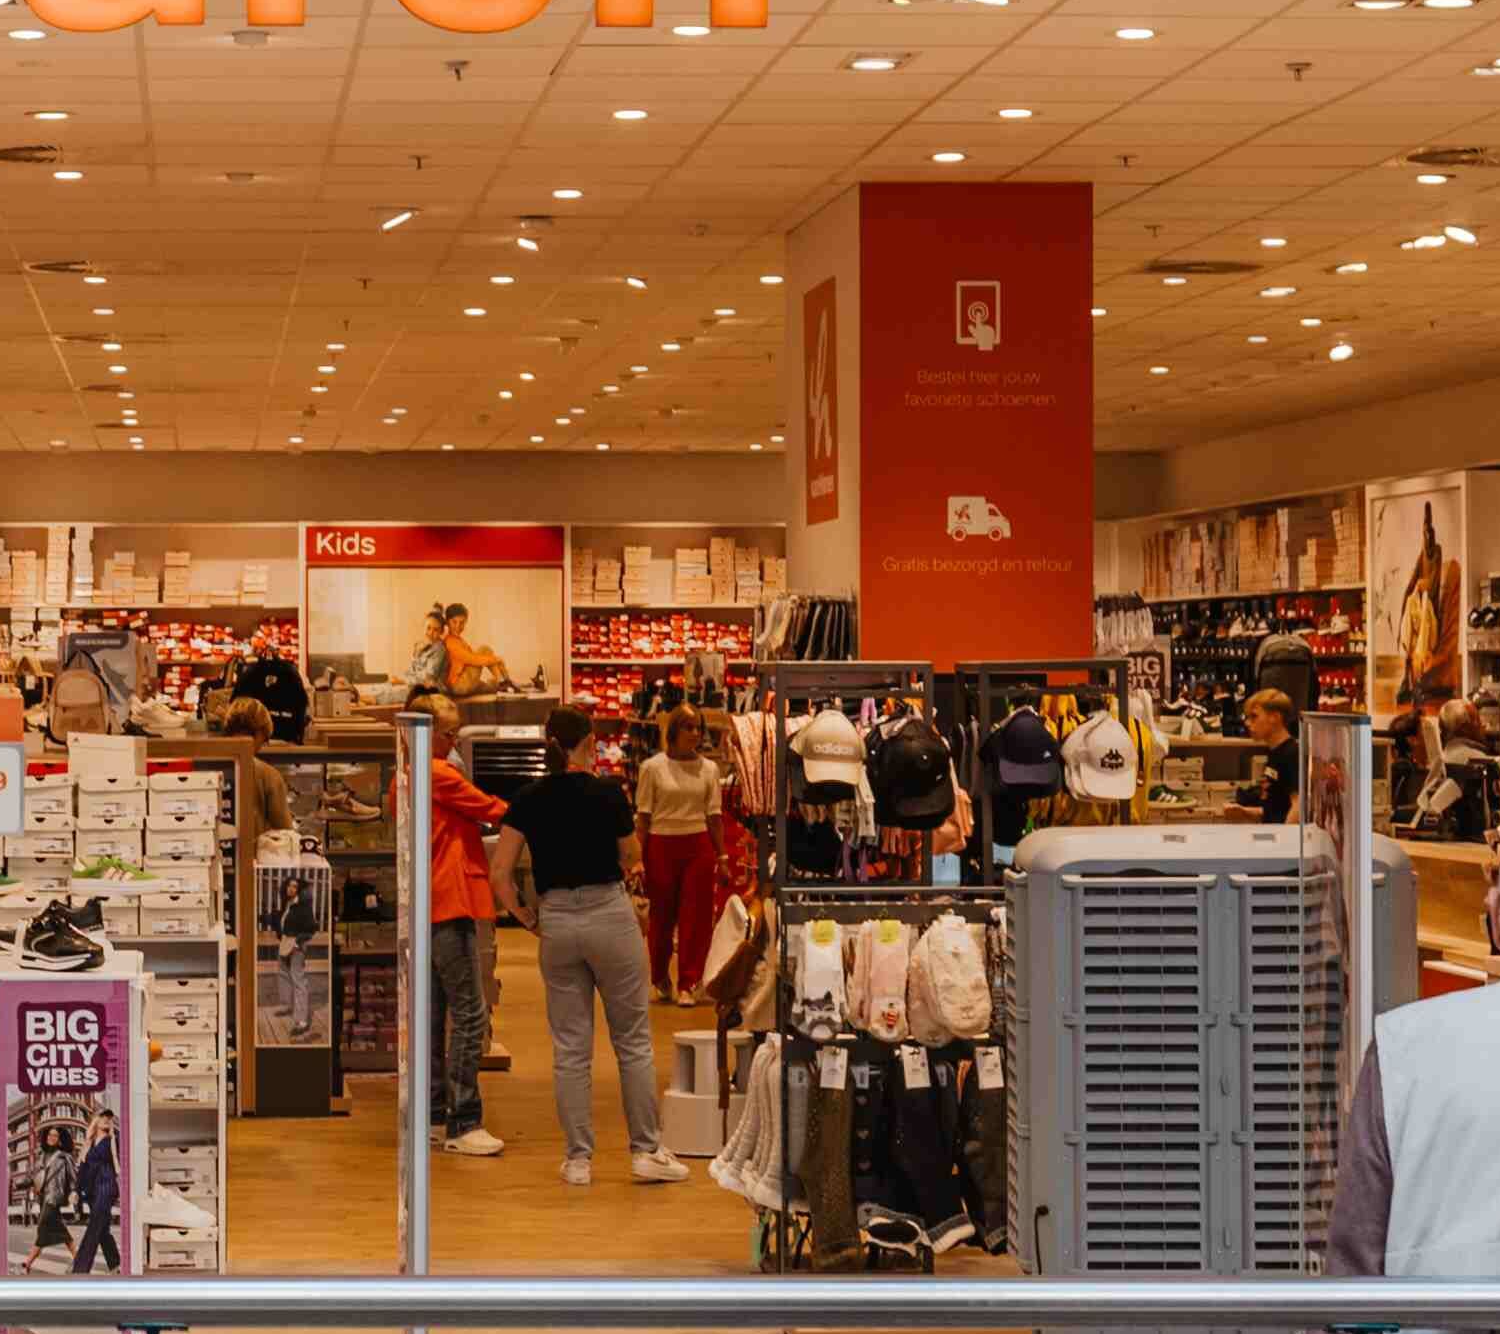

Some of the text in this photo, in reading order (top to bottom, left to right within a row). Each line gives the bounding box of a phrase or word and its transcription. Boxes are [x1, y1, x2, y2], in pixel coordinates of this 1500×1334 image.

[316, 530, 376, 556] Kids
[26, 1009, 99, 1042] BIG
[26, 1043, 99, 1067] CITY
[26, 1067, 99, 1086] VIBES
